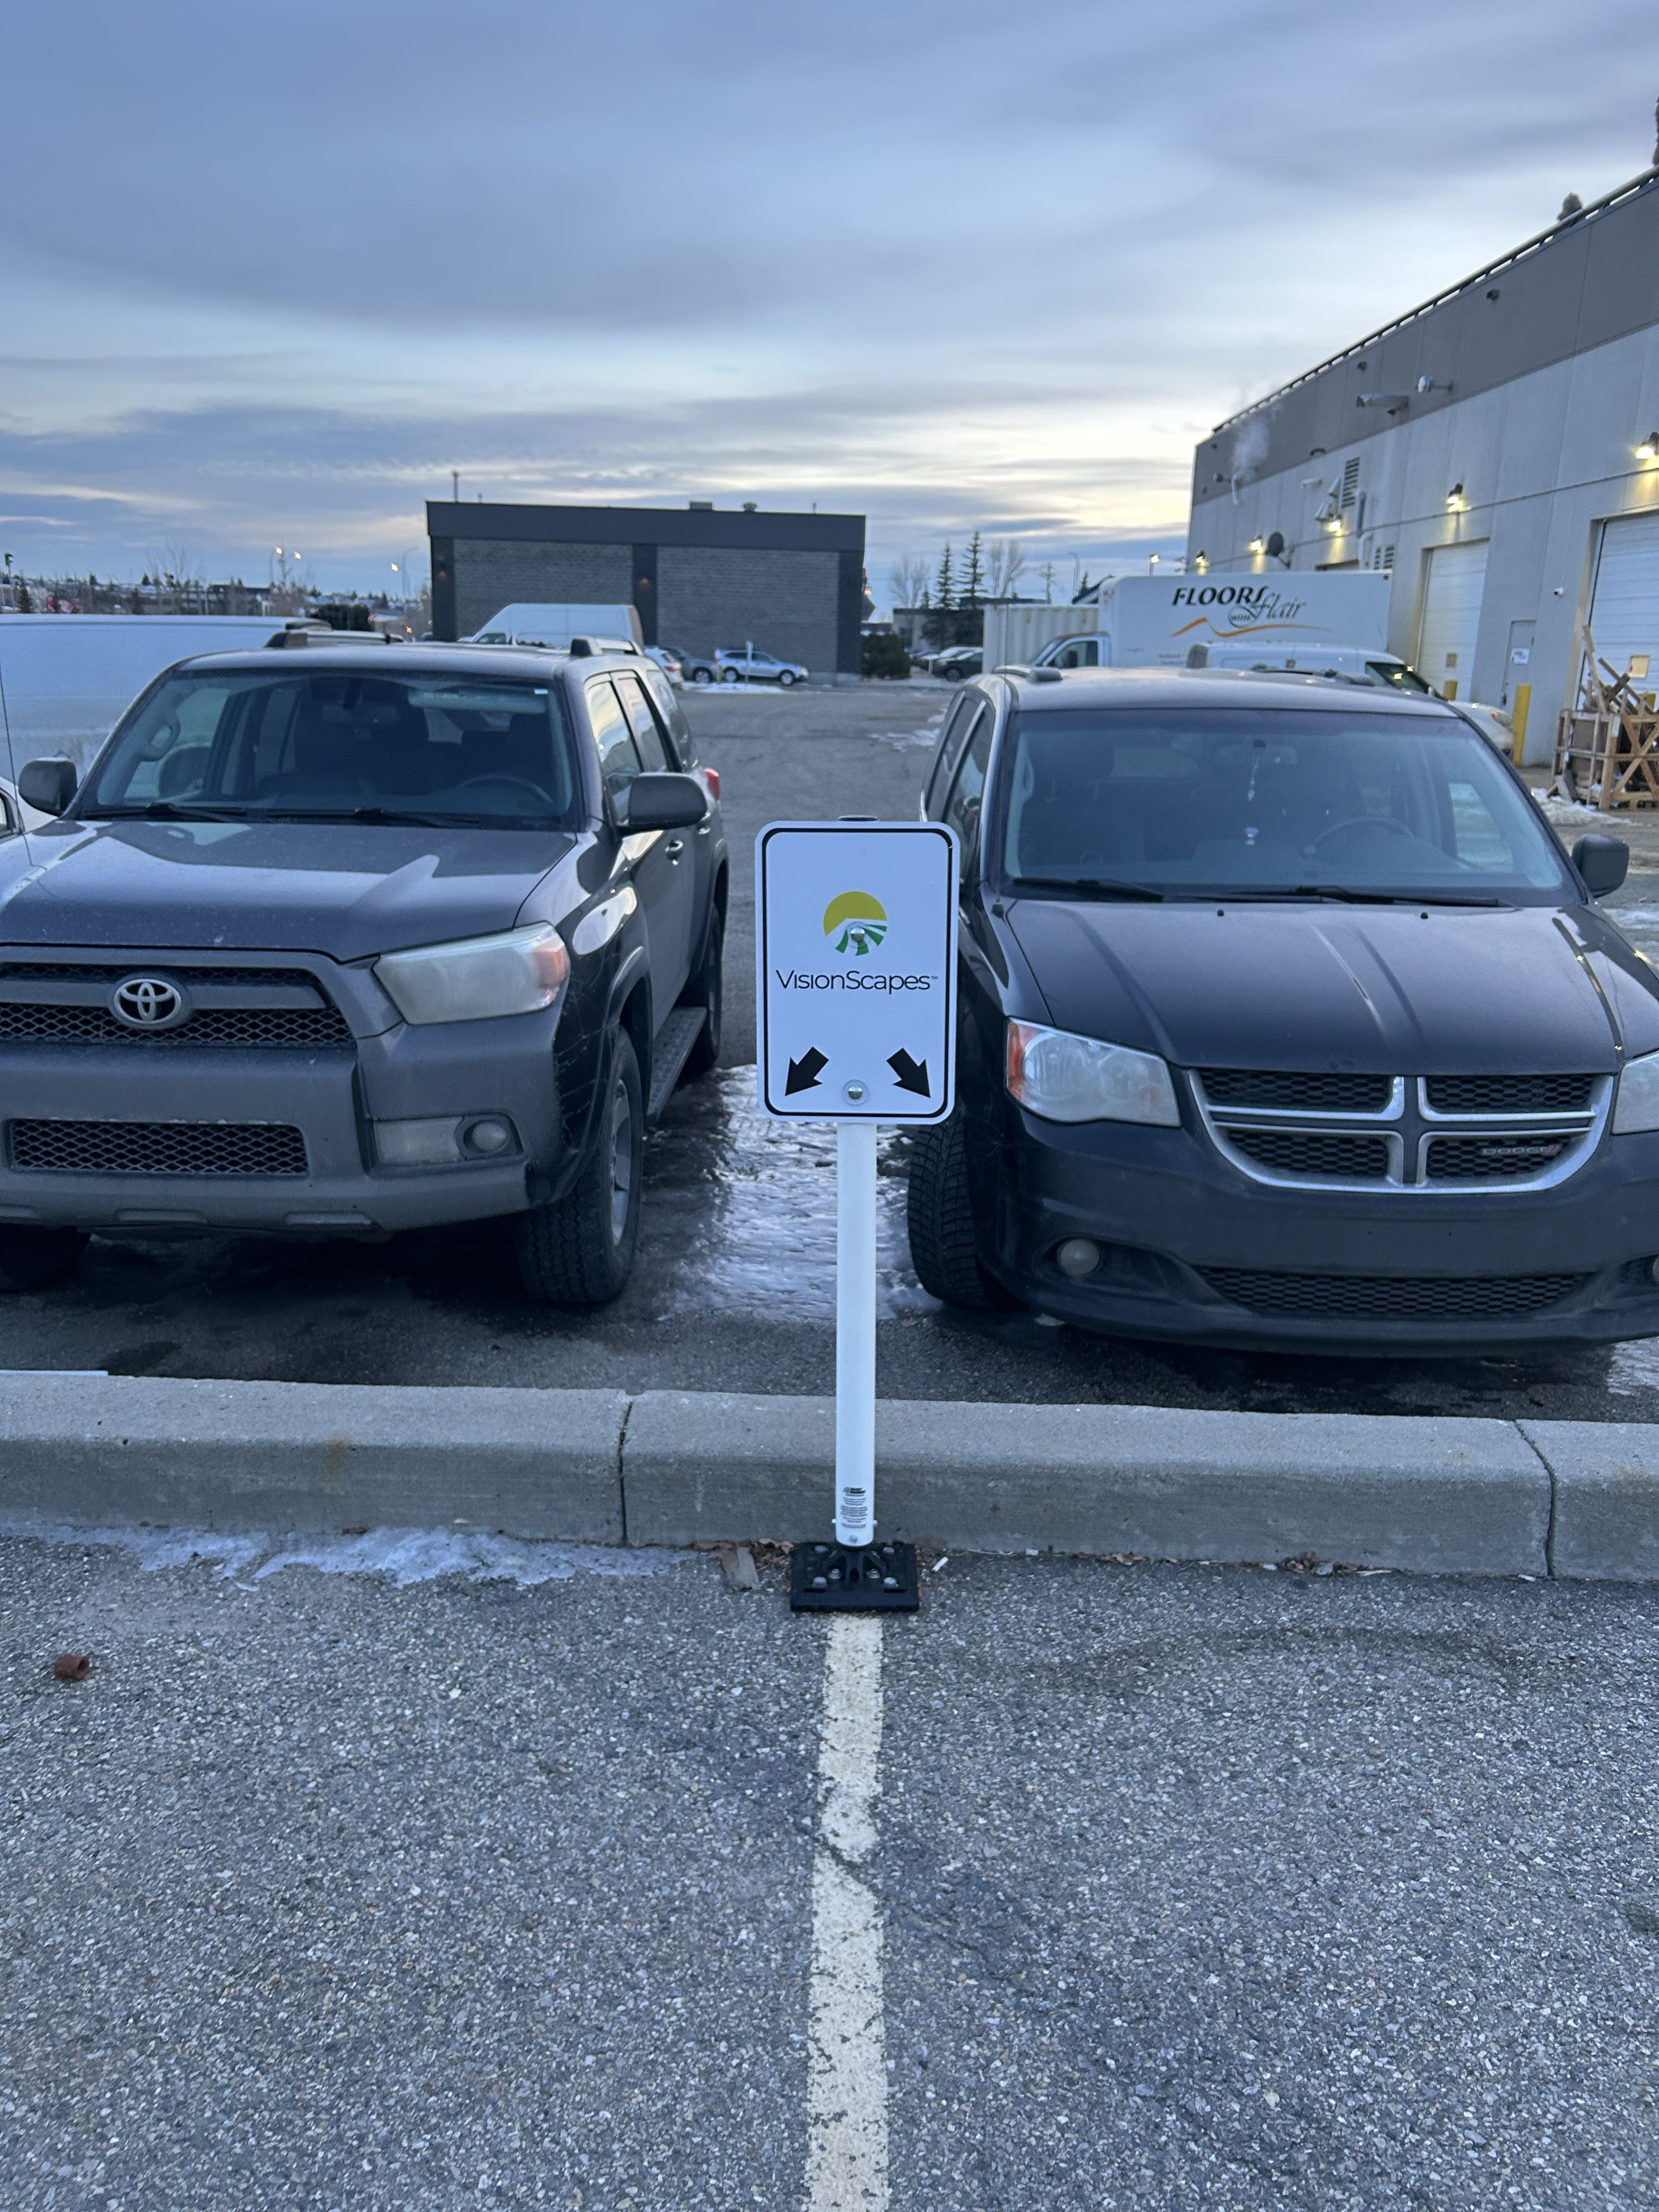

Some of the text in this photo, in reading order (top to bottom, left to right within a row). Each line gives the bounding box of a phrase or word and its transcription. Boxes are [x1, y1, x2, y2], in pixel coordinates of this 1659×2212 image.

[1172, 585, 1269, 606] FLOORS
[776, 970, 930, 995] VisionScapes
[1482, 1146, 1546, 1156] DODGE
